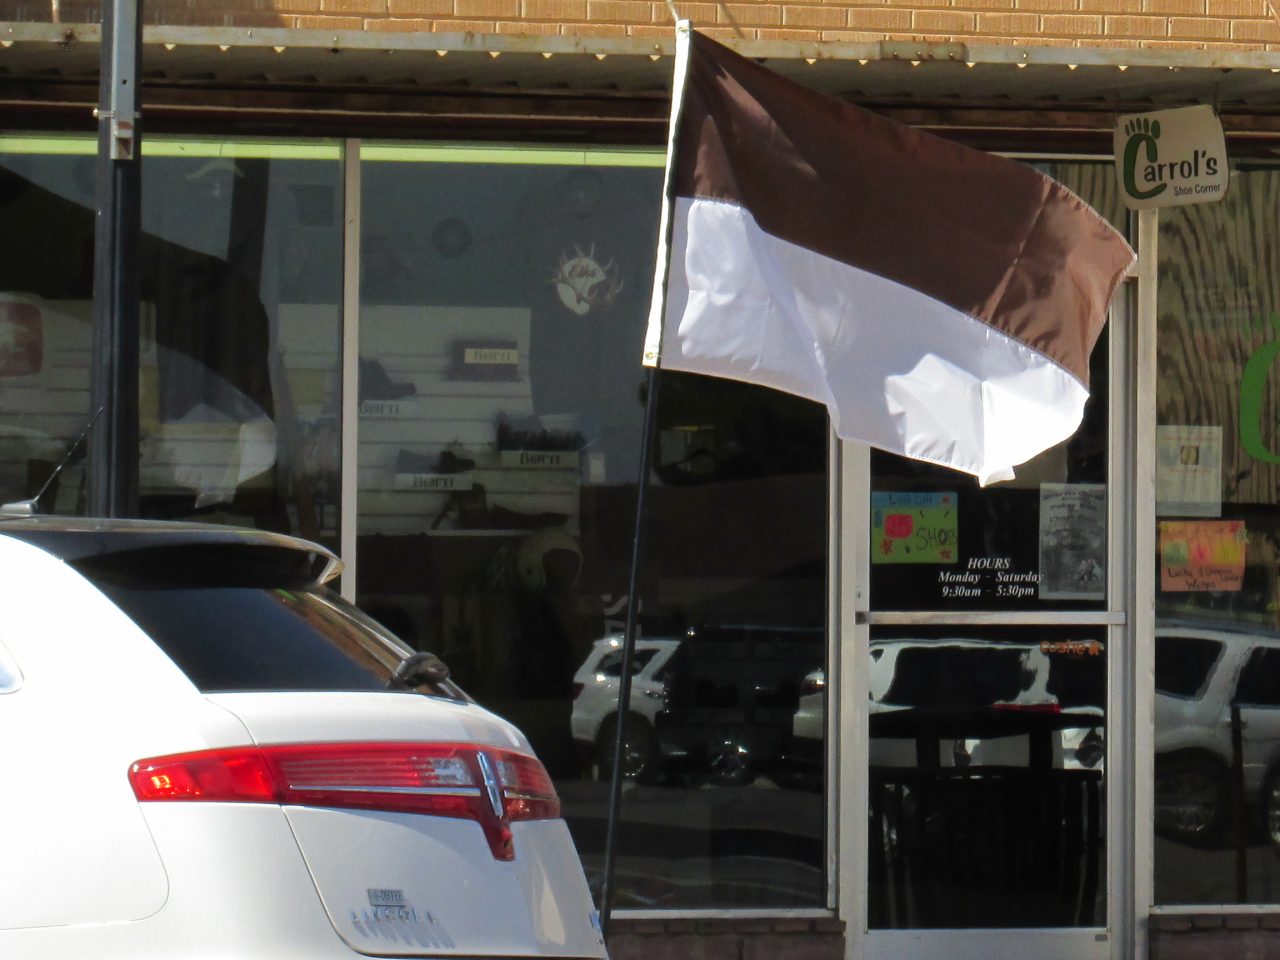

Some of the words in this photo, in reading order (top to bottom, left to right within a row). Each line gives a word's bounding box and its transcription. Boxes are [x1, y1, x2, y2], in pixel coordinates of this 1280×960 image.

[1123, 133, 1218, 200] Carrol's
[1173, 185, 1193, 197] Shoe
[1194, 183, 1222, 194] Corner
[967, 558, 1011, 569] HOURS
[938, 571, 981, 584] Monday
[995, 571, 1043, 584] Saturday
[942, 585, 981, 597] 9:30am
[996, 585, 1034, 598] 5:30pm
